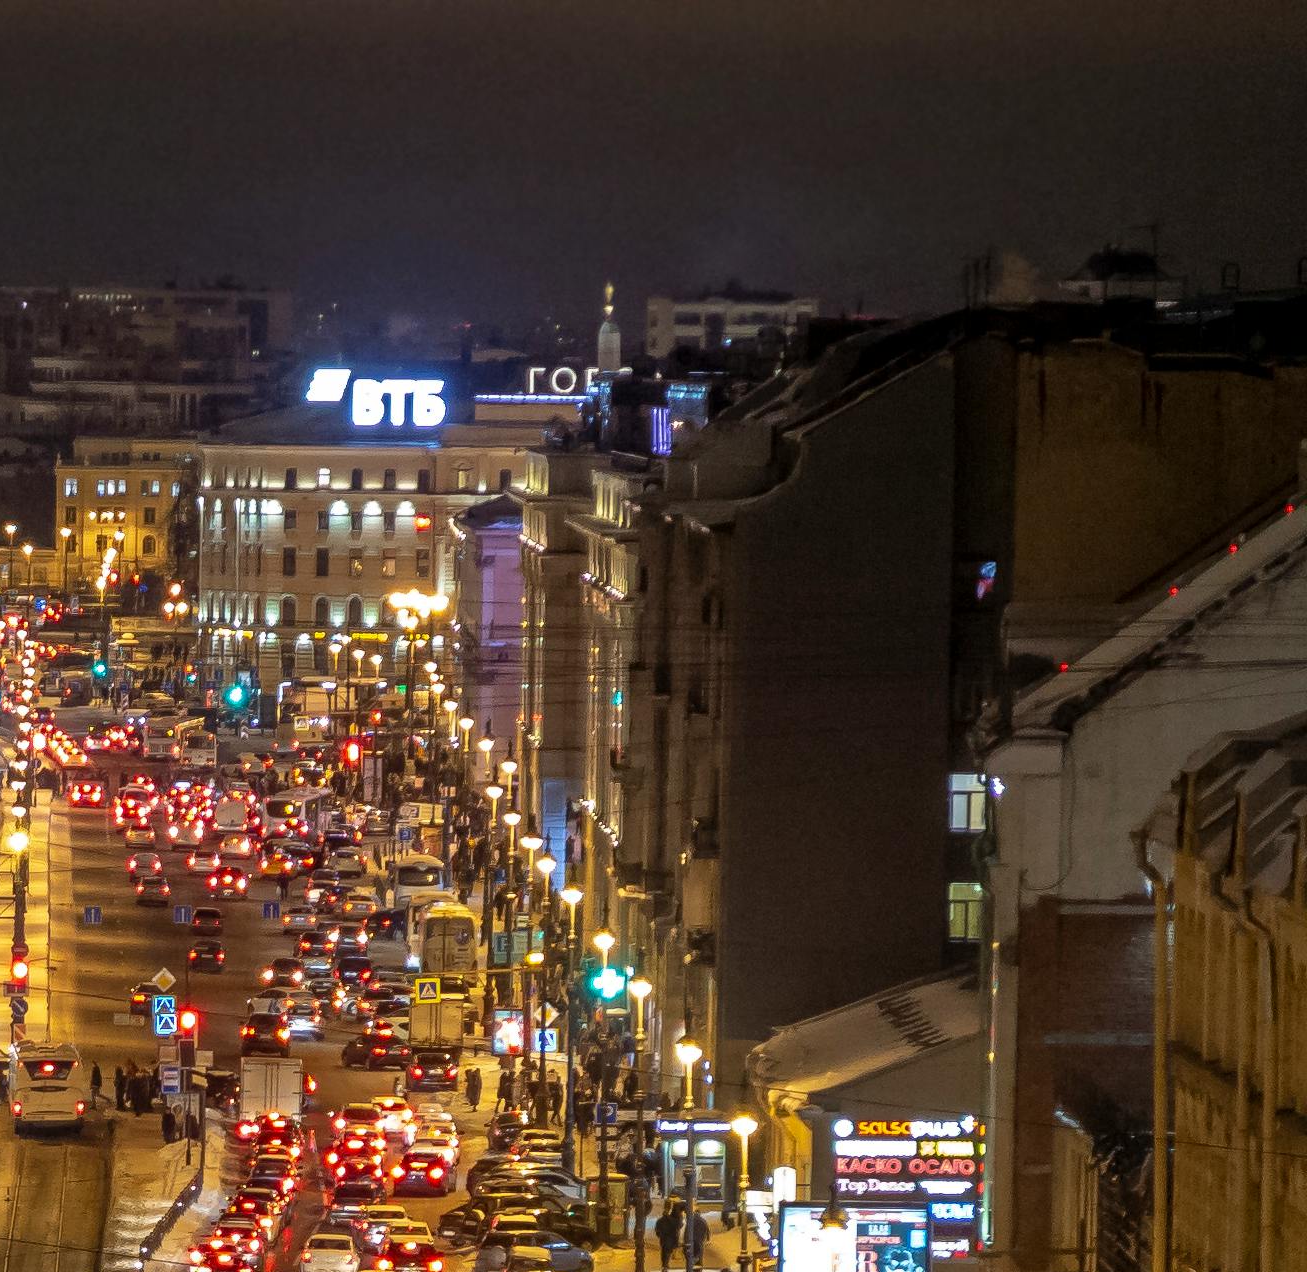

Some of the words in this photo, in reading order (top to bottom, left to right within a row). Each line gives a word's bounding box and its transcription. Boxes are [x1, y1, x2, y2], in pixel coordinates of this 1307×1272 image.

[352, 378, 447, 427] ВТБ
[836, 1158, 902, 1175] КАСКО
[908, 1159, 976, 1175] ОСАГО
